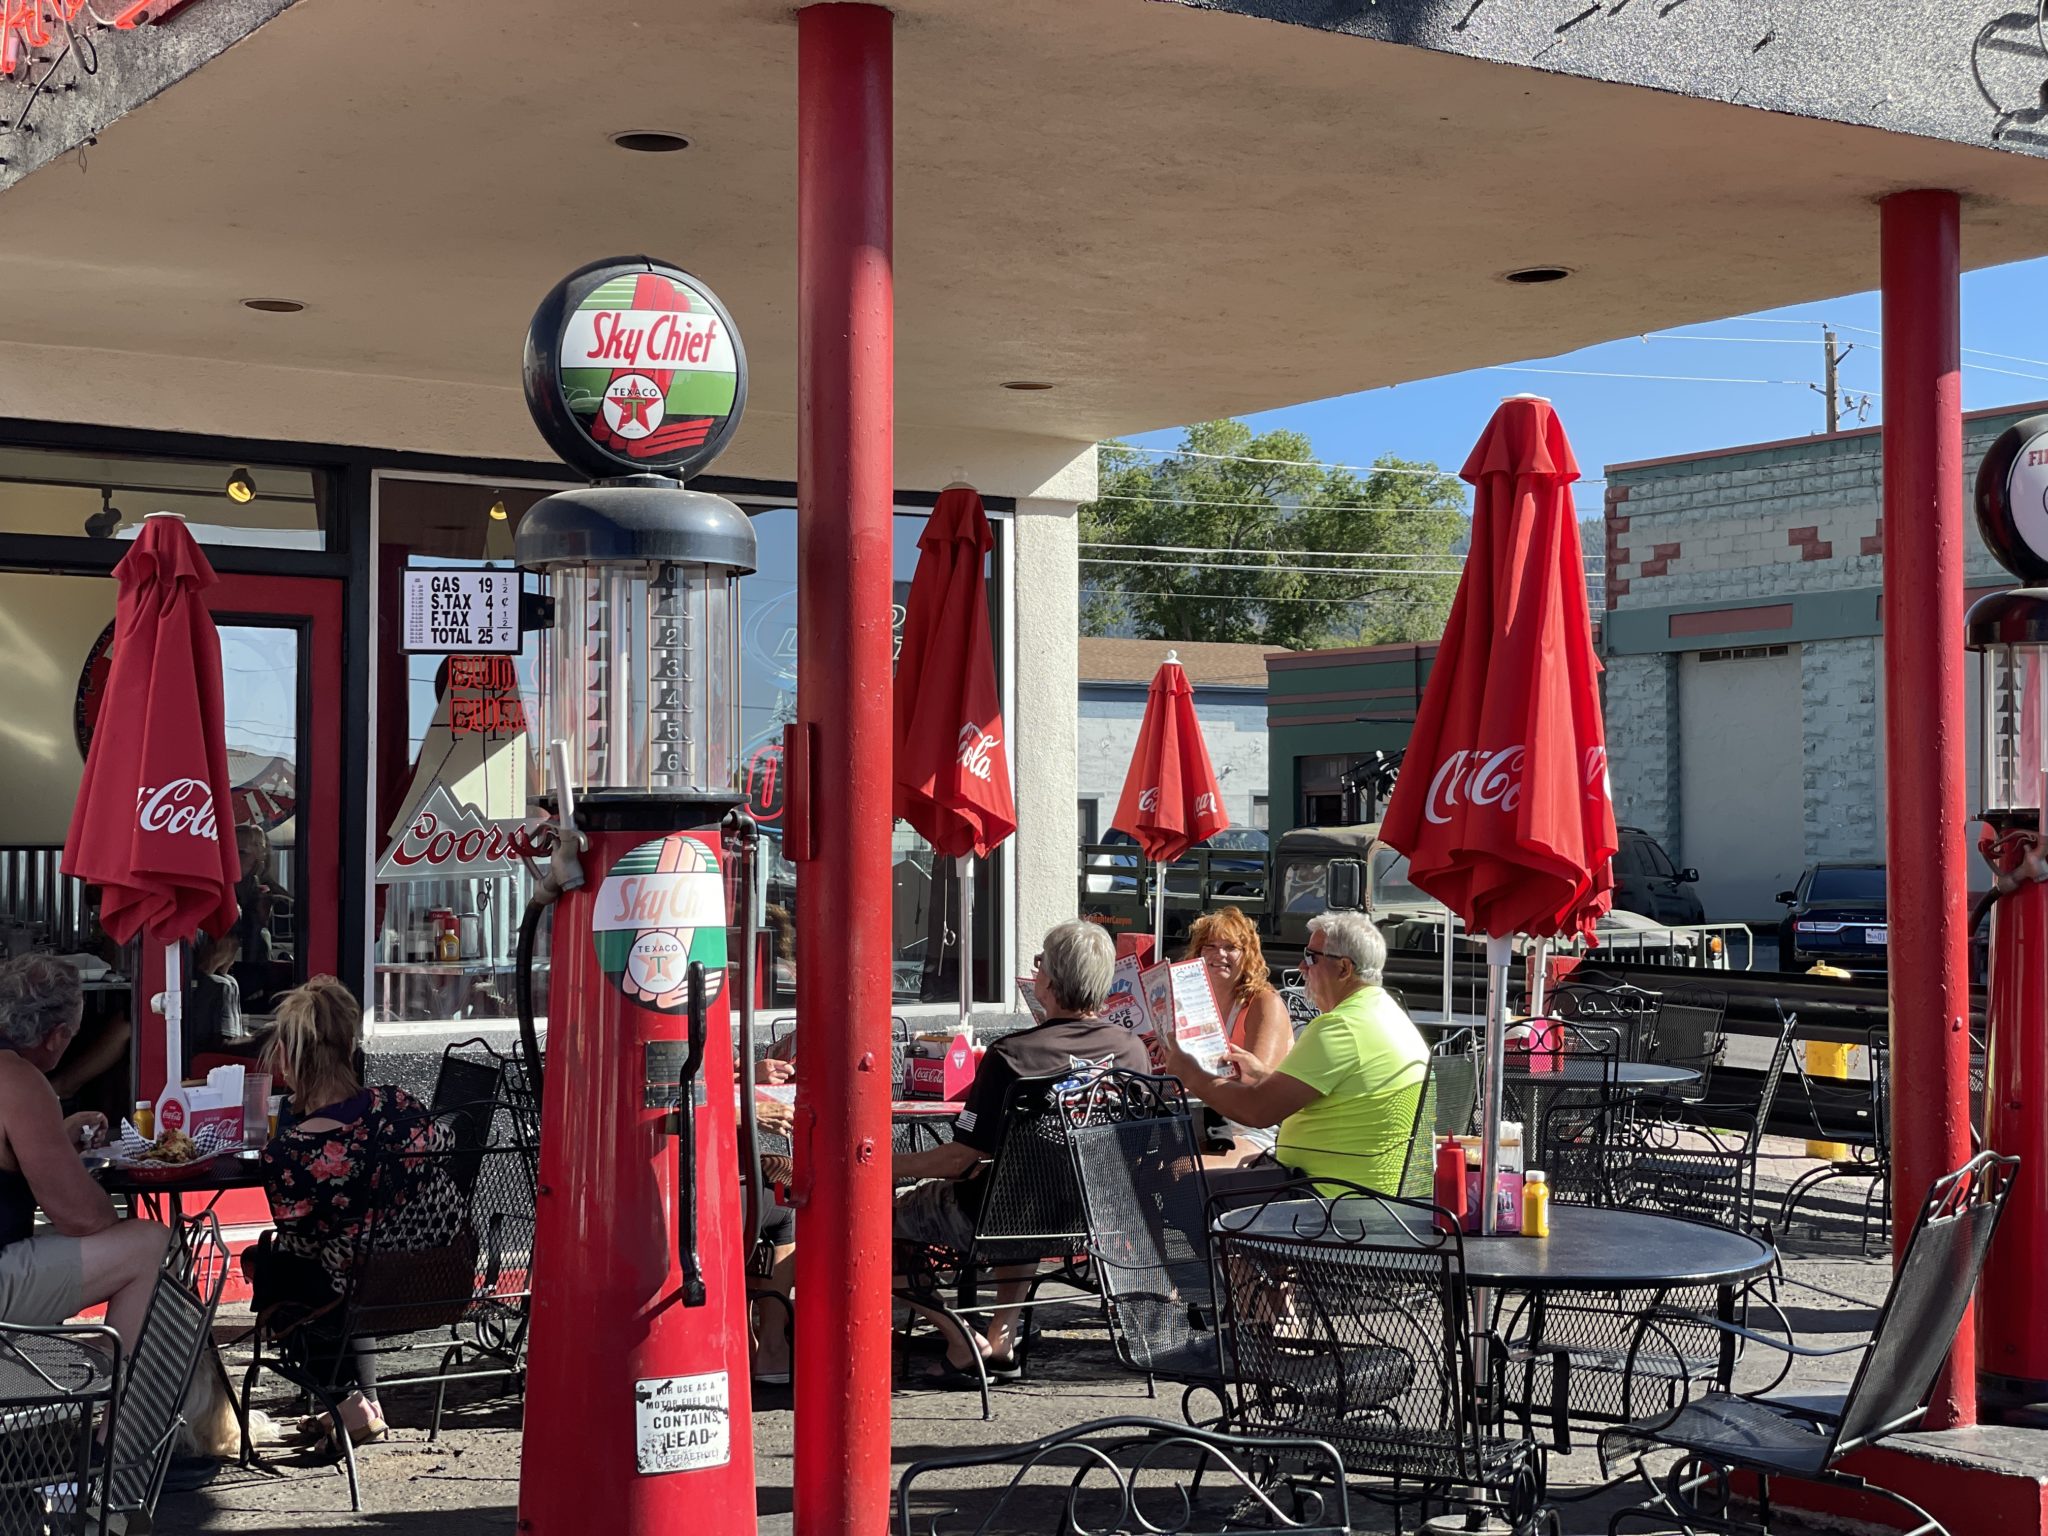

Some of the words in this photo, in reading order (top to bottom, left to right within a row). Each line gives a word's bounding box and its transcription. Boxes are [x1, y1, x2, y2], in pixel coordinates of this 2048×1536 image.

[587, 312, 644, 366] Sky
[646, 315, 717, 363] Chief
[613, 387, 658, 398] TEXACO
[431, 576, 460, 593] GAS
[478, 577, 493, 593] 19
[431, 594, 472, 610] S.TAX
[485, 595, 494, 610] 4
[431, 611, 470, 627] F.TAX
[487, 612, 493, 627] 1
[431, 628, 473, 644] TOTAL
[477, 629, 493, 644] 25
[666, 628, 677, 645] 2
[666, 659, 678, 677] 3
[665, 690, 679, 706] 4
[666, 722, 679, 740] 5
[667, 753, 678, 771] 6
[614, 877, 669, 925] Sky
[638, 945, 678, 953] TEXACO
[1108, 1008, 1131, 1022] CAFE
[677, 1384, 693, 1394] USE
[697, 1384, 707, 1392] AS
[710, 1381, 715, 1389] A
[705, 1393, 722, 1403] ONLY
[653, 1411, 719, 1430] CONTAINS
[666, 1428, 709, 1449] LEAD
